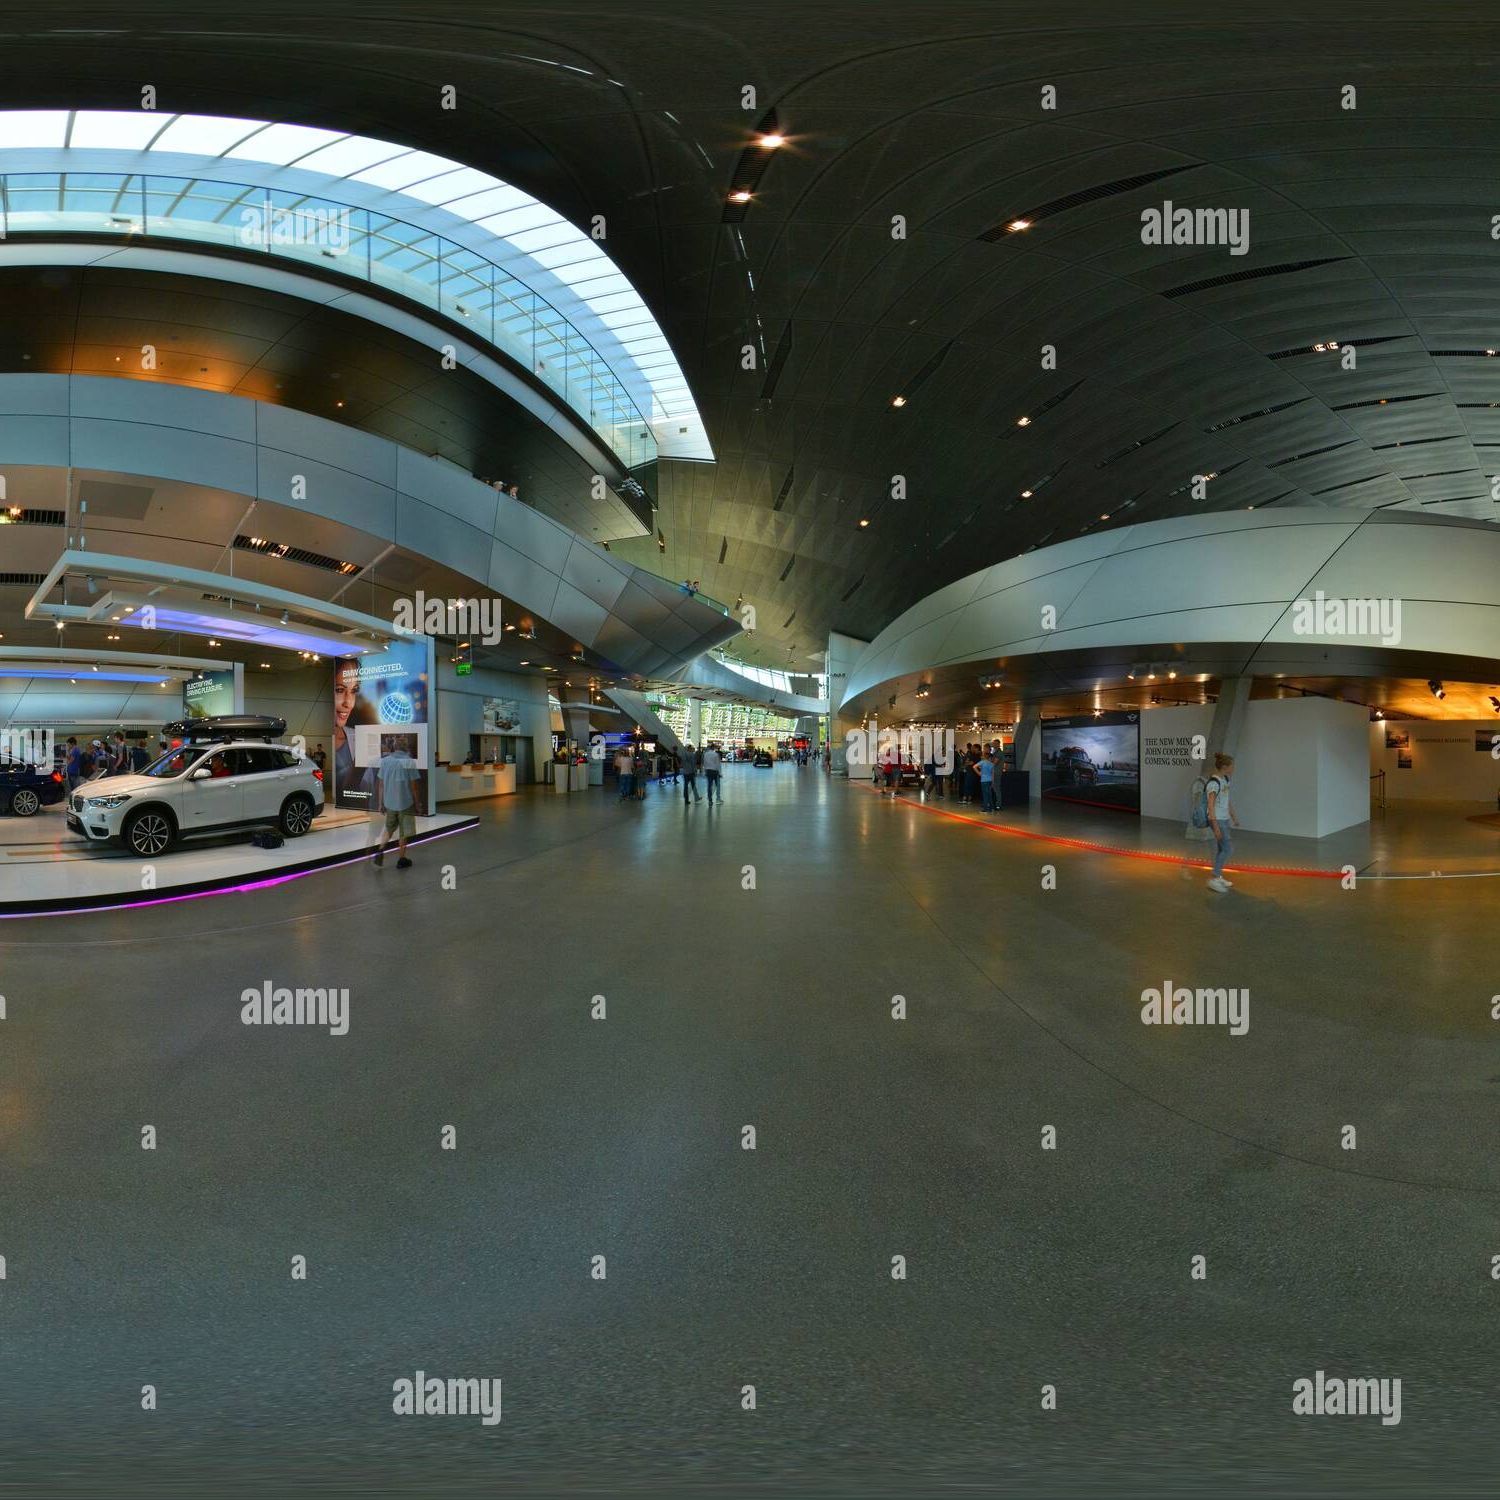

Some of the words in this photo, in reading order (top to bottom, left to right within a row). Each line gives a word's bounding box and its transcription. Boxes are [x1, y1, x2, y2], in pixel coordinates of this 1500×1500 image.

[342, 667, 359, 678] BMW
[1145, 738, 1157, 746] THE
[1159, 738, 1174, 746] NEW
[1145, 748, 1161, 756] JOHN
[1162, 748, 1189, 756] COOPER
[1145, 758, 1170, 766] COMING
